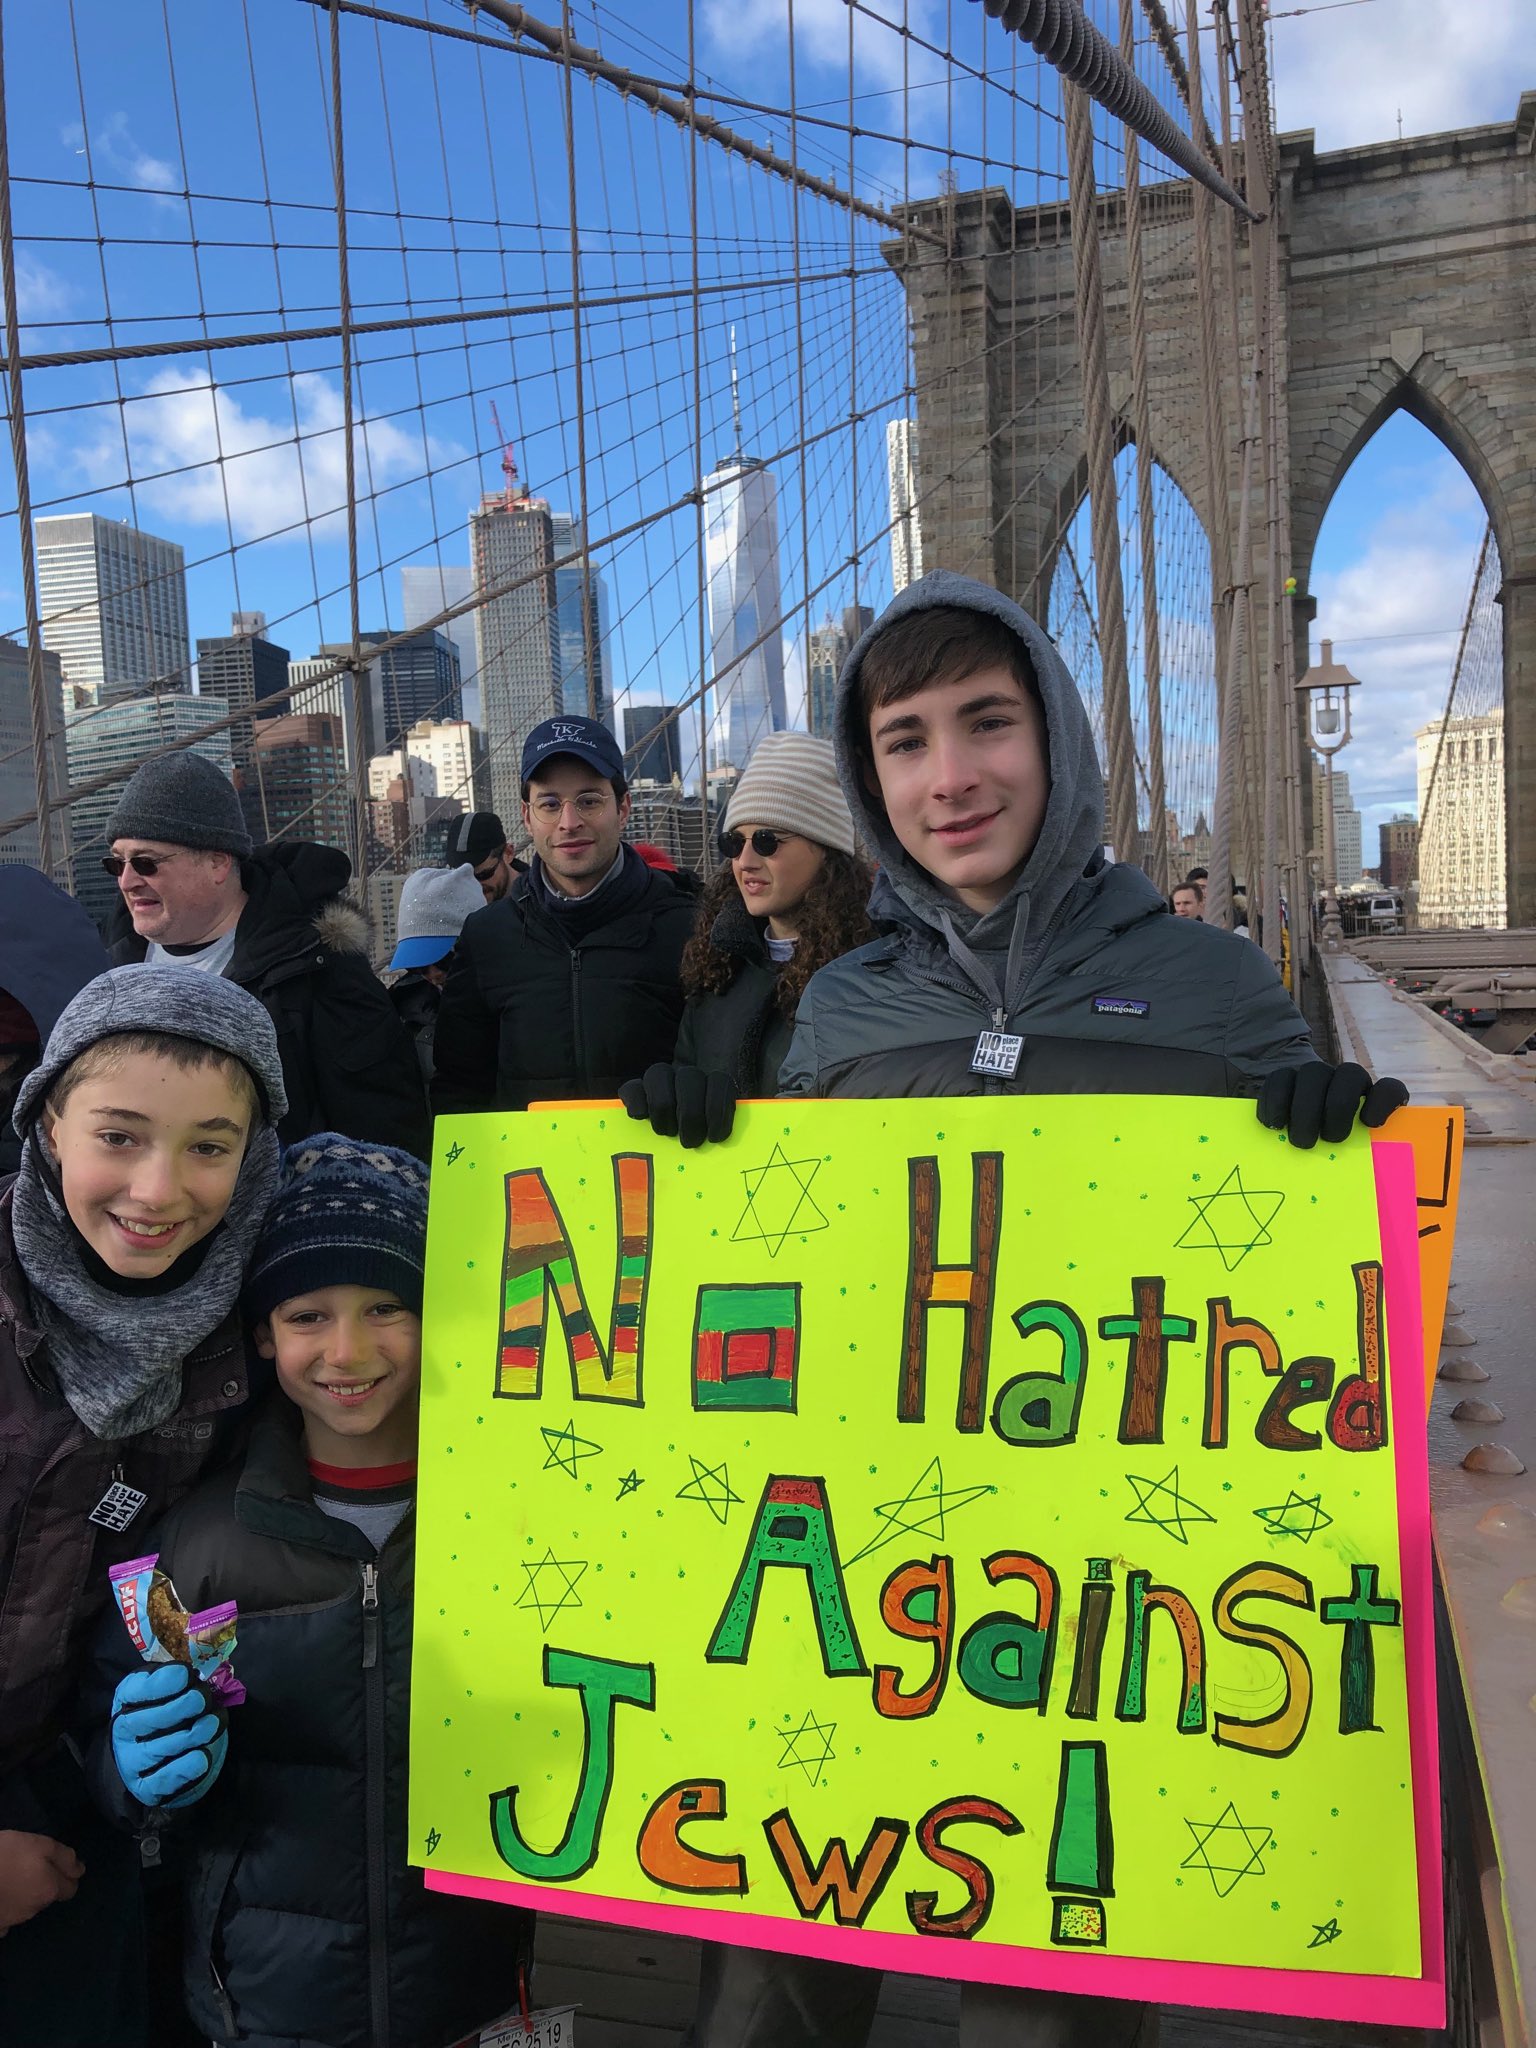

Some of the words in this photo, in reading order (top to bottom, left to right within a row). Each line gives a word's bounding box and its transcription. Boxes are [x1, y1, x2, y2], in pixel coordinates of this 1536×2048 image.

[562, 726, 572, 734] K
[1098, 1004, 1143, 1015] patagonia
[979, 1032, 1002, 1051] NO
[1001, 1045, 1019, 1053] for
[1002, 1036, 1020, 1045] place
[974, 1050, 1016, 1069] HATE
[493, 1152, 802, 1413] No
[896, 1151, 1389, 1452] Hatred
[91, 1500, 118, 1524] NO
[108, 1490, 144, 1529] HATE
[120, 1586, 139, 1636] CLIF
[706, 1474, 1401, 1760] Against
[489, 1643, 1115, 1947] Jews!
[526, 2030, 541, 2048] 25
[547, 2022, 561, 2046] 19
